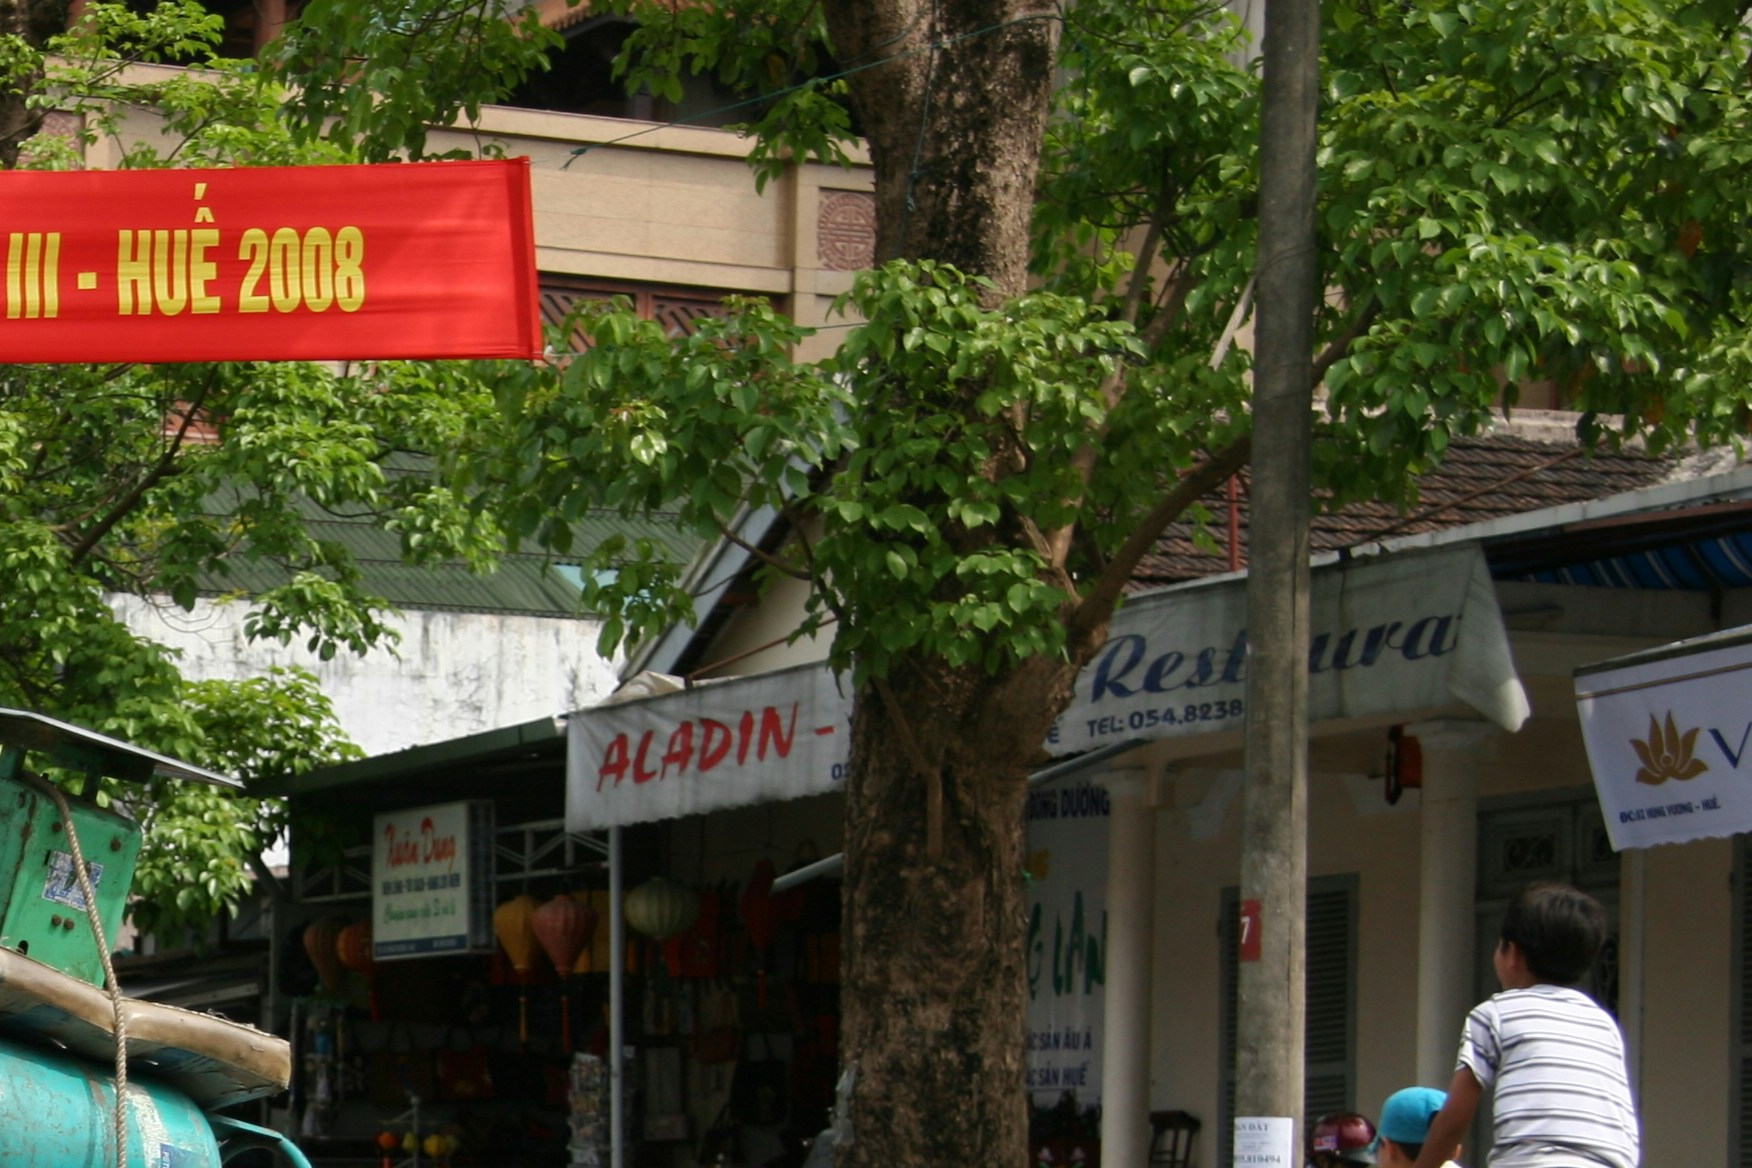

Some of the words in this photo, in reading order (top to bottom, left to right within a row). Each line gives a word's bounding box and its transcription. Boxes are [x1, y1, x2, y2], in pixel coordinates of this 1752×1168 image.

[7, 232, 60, 319] III
[118, 183, 221, 316] HUẾ
[238, 226, 365, 314] 2008
[596, 702, 799, 792] ALADIN
[1087, 716, 1125, 739] TEL:
